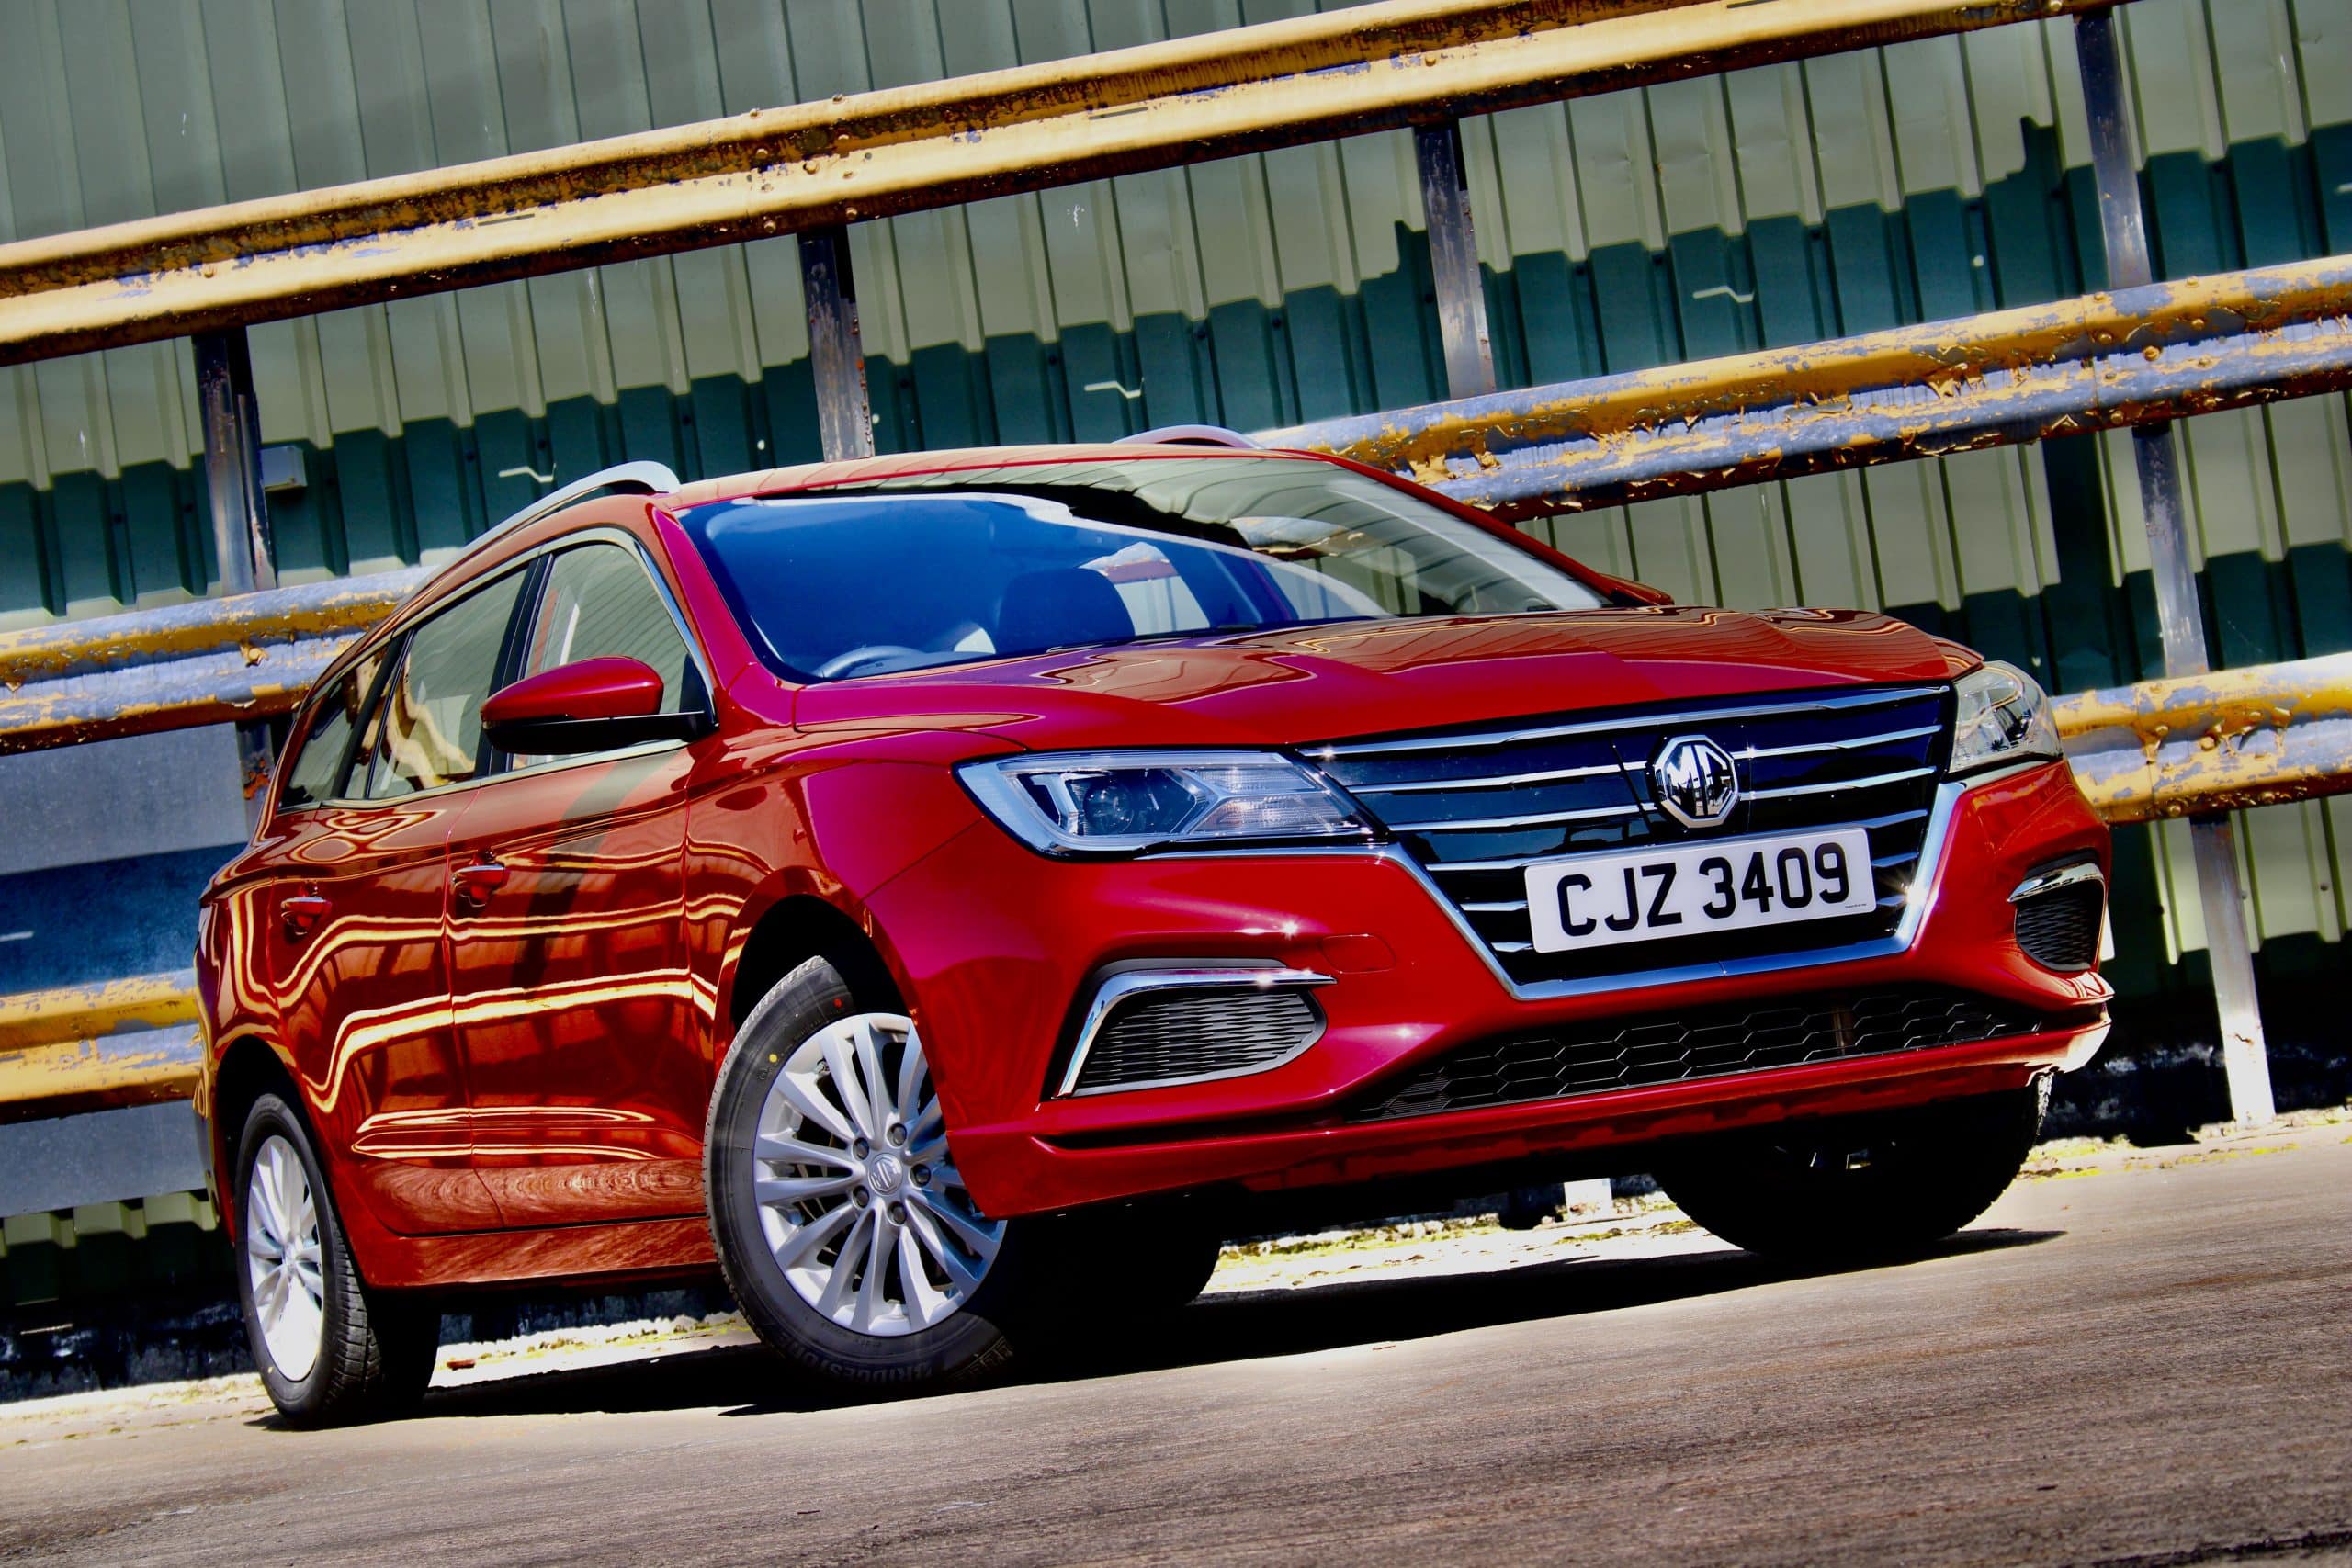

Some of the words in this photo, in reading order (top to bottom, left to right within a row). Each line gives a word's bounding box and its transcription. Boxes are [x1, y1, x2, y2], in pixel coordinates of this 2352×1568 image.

[1659, 739, 1735, 818] MG
[1557, 862, 1683, 937] CJZ
[1698, 841, 1850, 919] 3409
